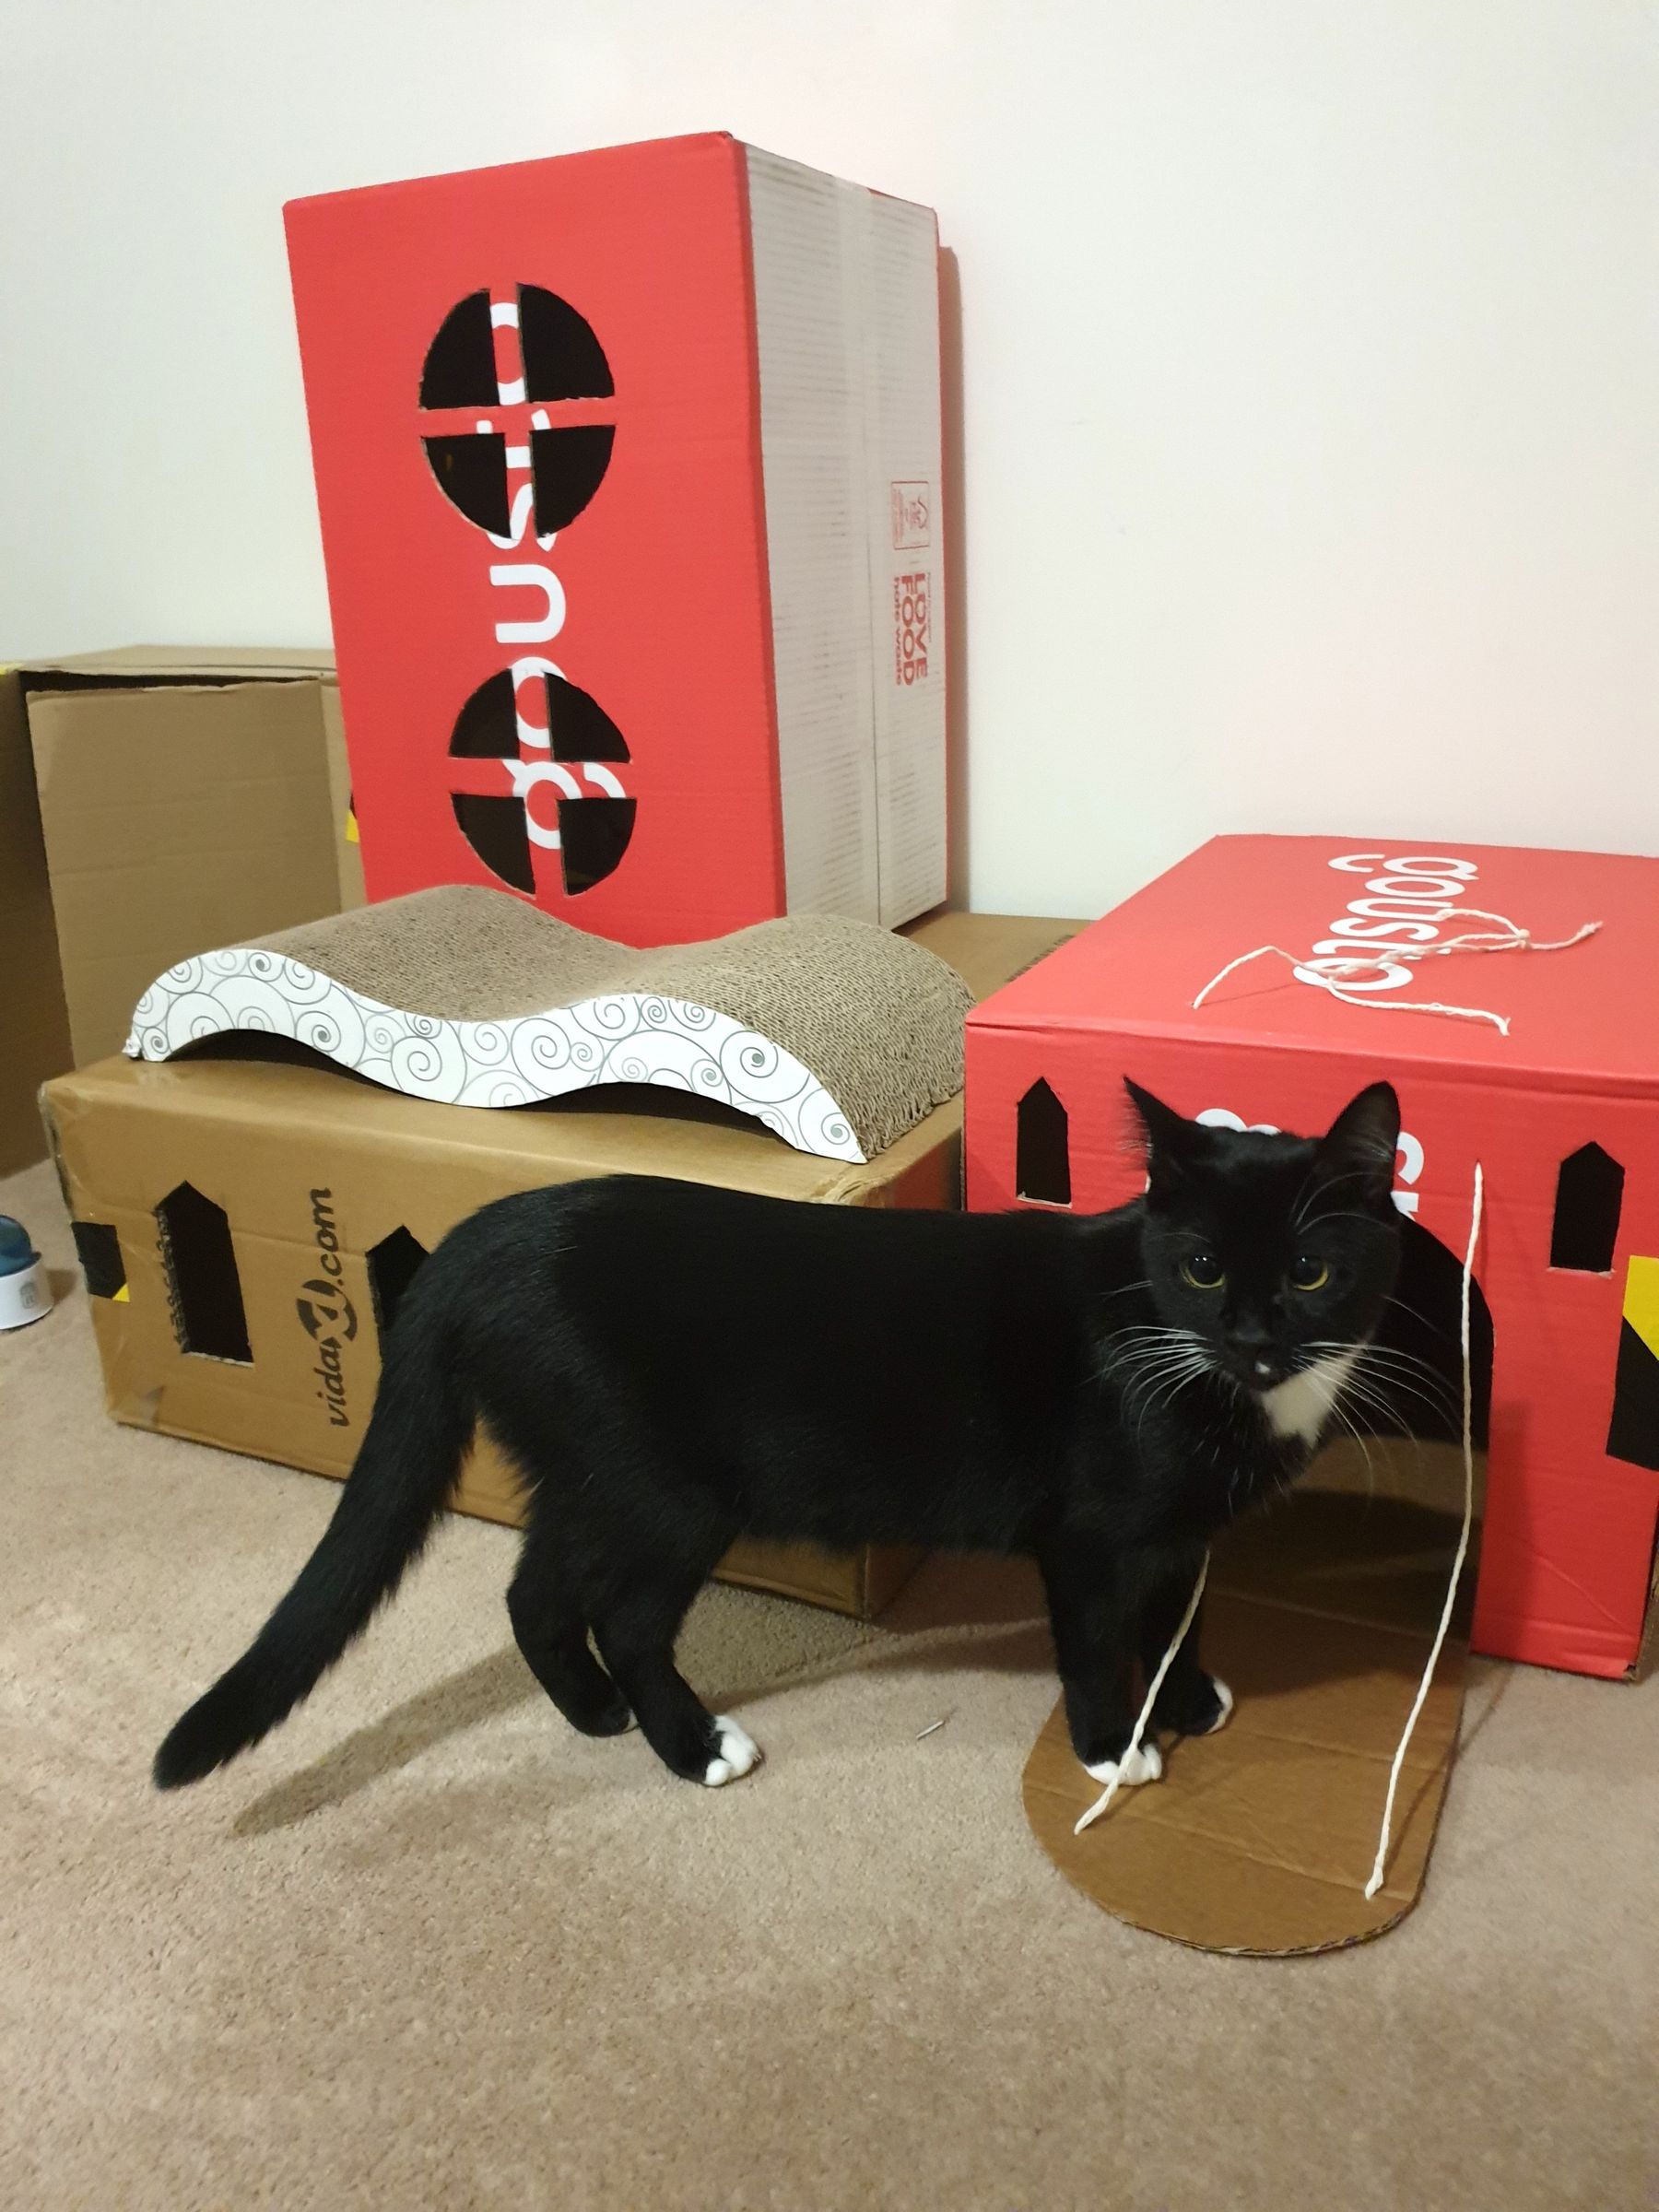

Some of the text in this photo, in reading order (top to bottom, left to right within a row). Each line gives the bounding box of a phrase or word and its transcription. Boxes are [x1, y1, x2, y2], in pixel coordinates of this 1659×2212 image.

[900, 574, 915, 686] FOOD
[912, 572, 928, 679] LOVE
[1292, 853, 1479, 991] gousto
